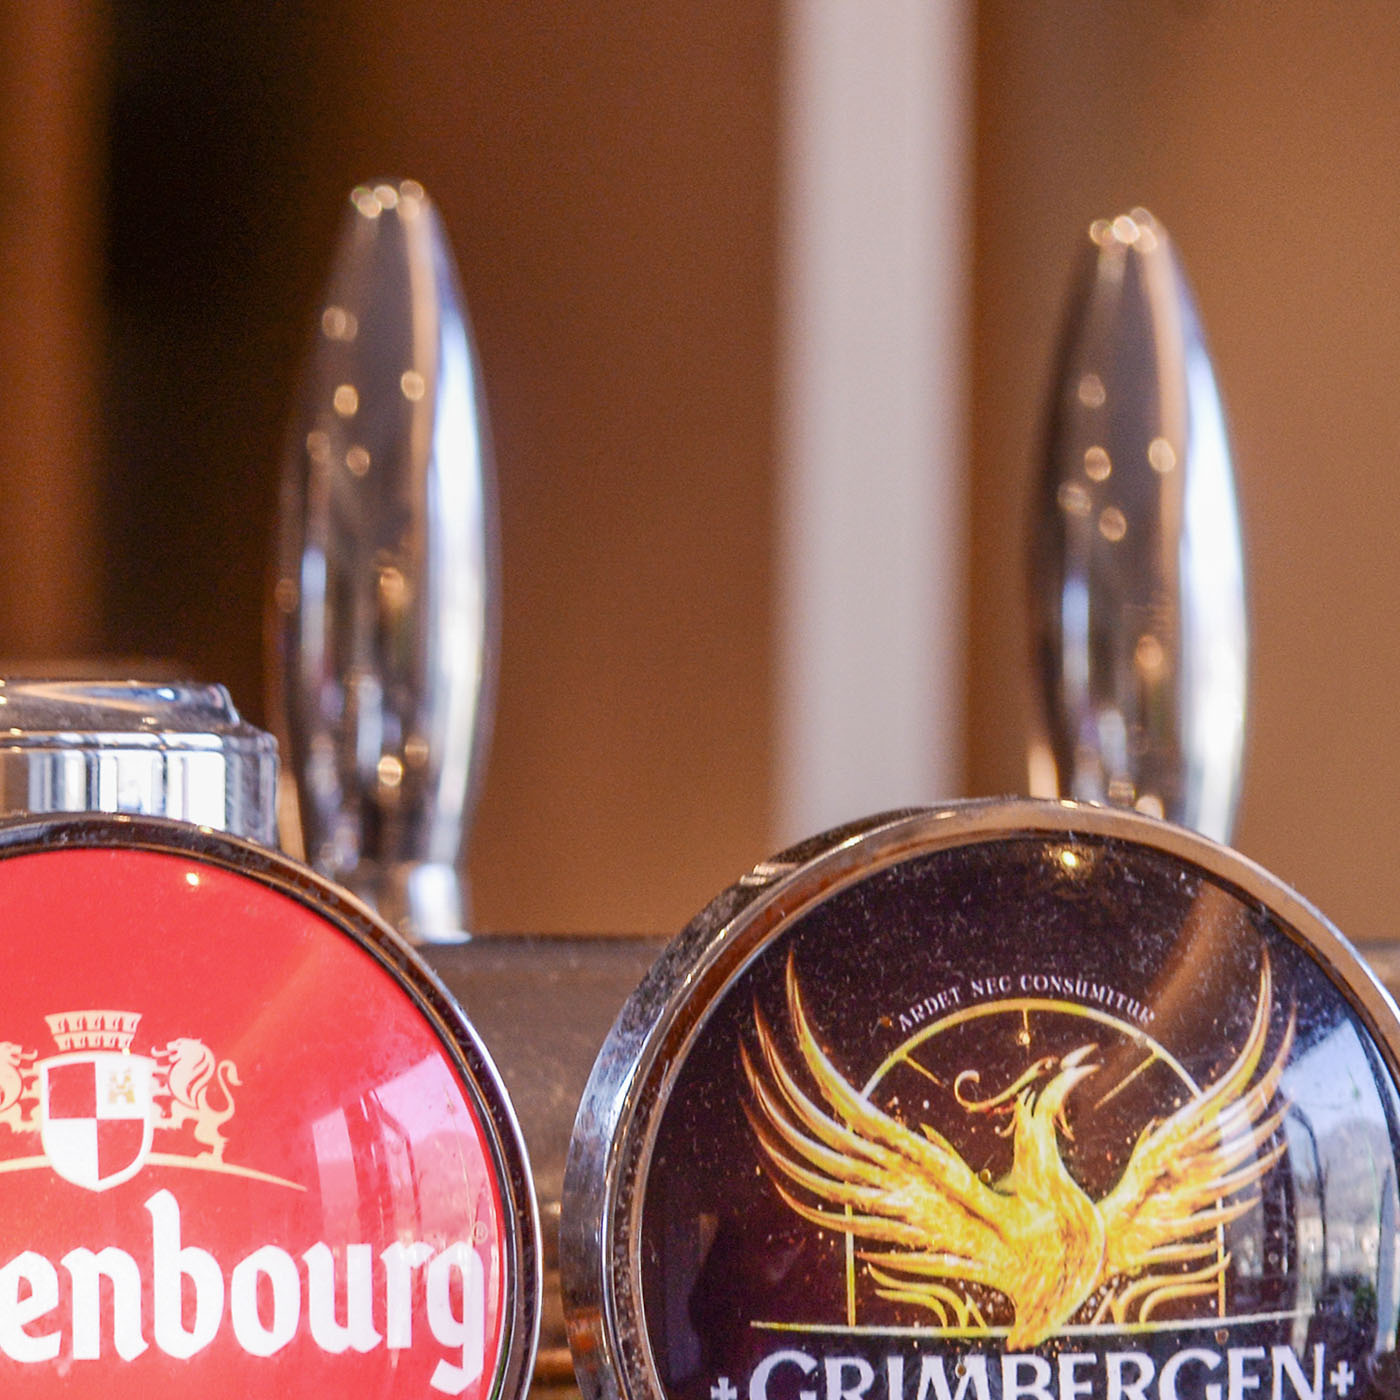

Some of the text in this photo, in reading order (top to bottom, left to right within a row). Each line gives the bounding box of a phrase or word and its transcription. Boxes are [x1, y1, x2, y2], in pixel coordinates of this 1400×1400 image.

[898, 973, 1156, 1033] ARDET NEC CONSUMITUR
